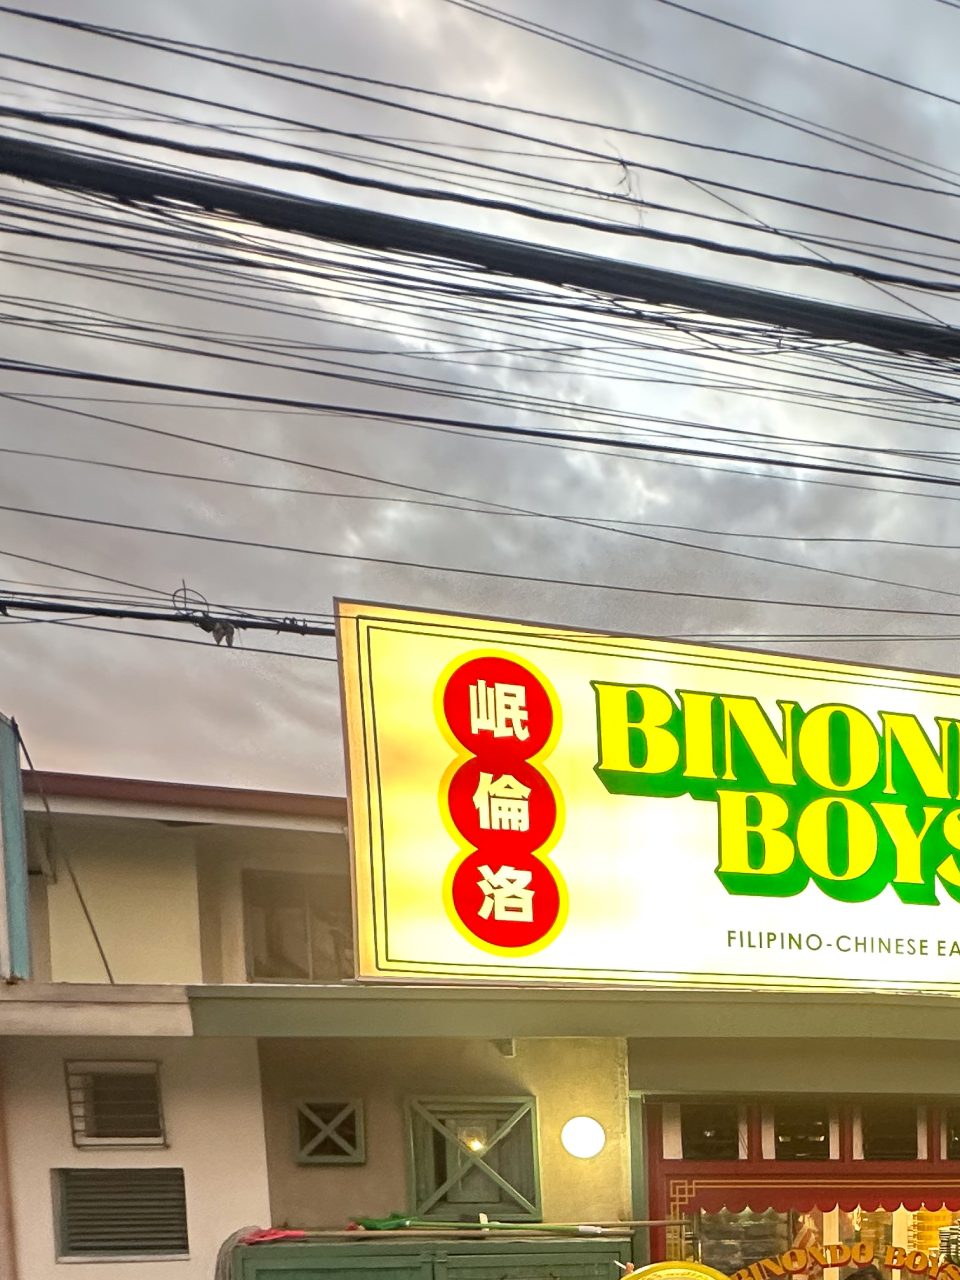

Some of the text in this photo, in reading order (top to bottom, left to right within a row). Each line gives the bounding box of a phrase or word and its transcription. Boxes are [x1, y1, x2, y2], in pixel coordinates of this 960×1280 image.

[468, 678, 536, 924] 岷倫洛
[726, 929, 929, 957] FILIPINO-CHINESE
